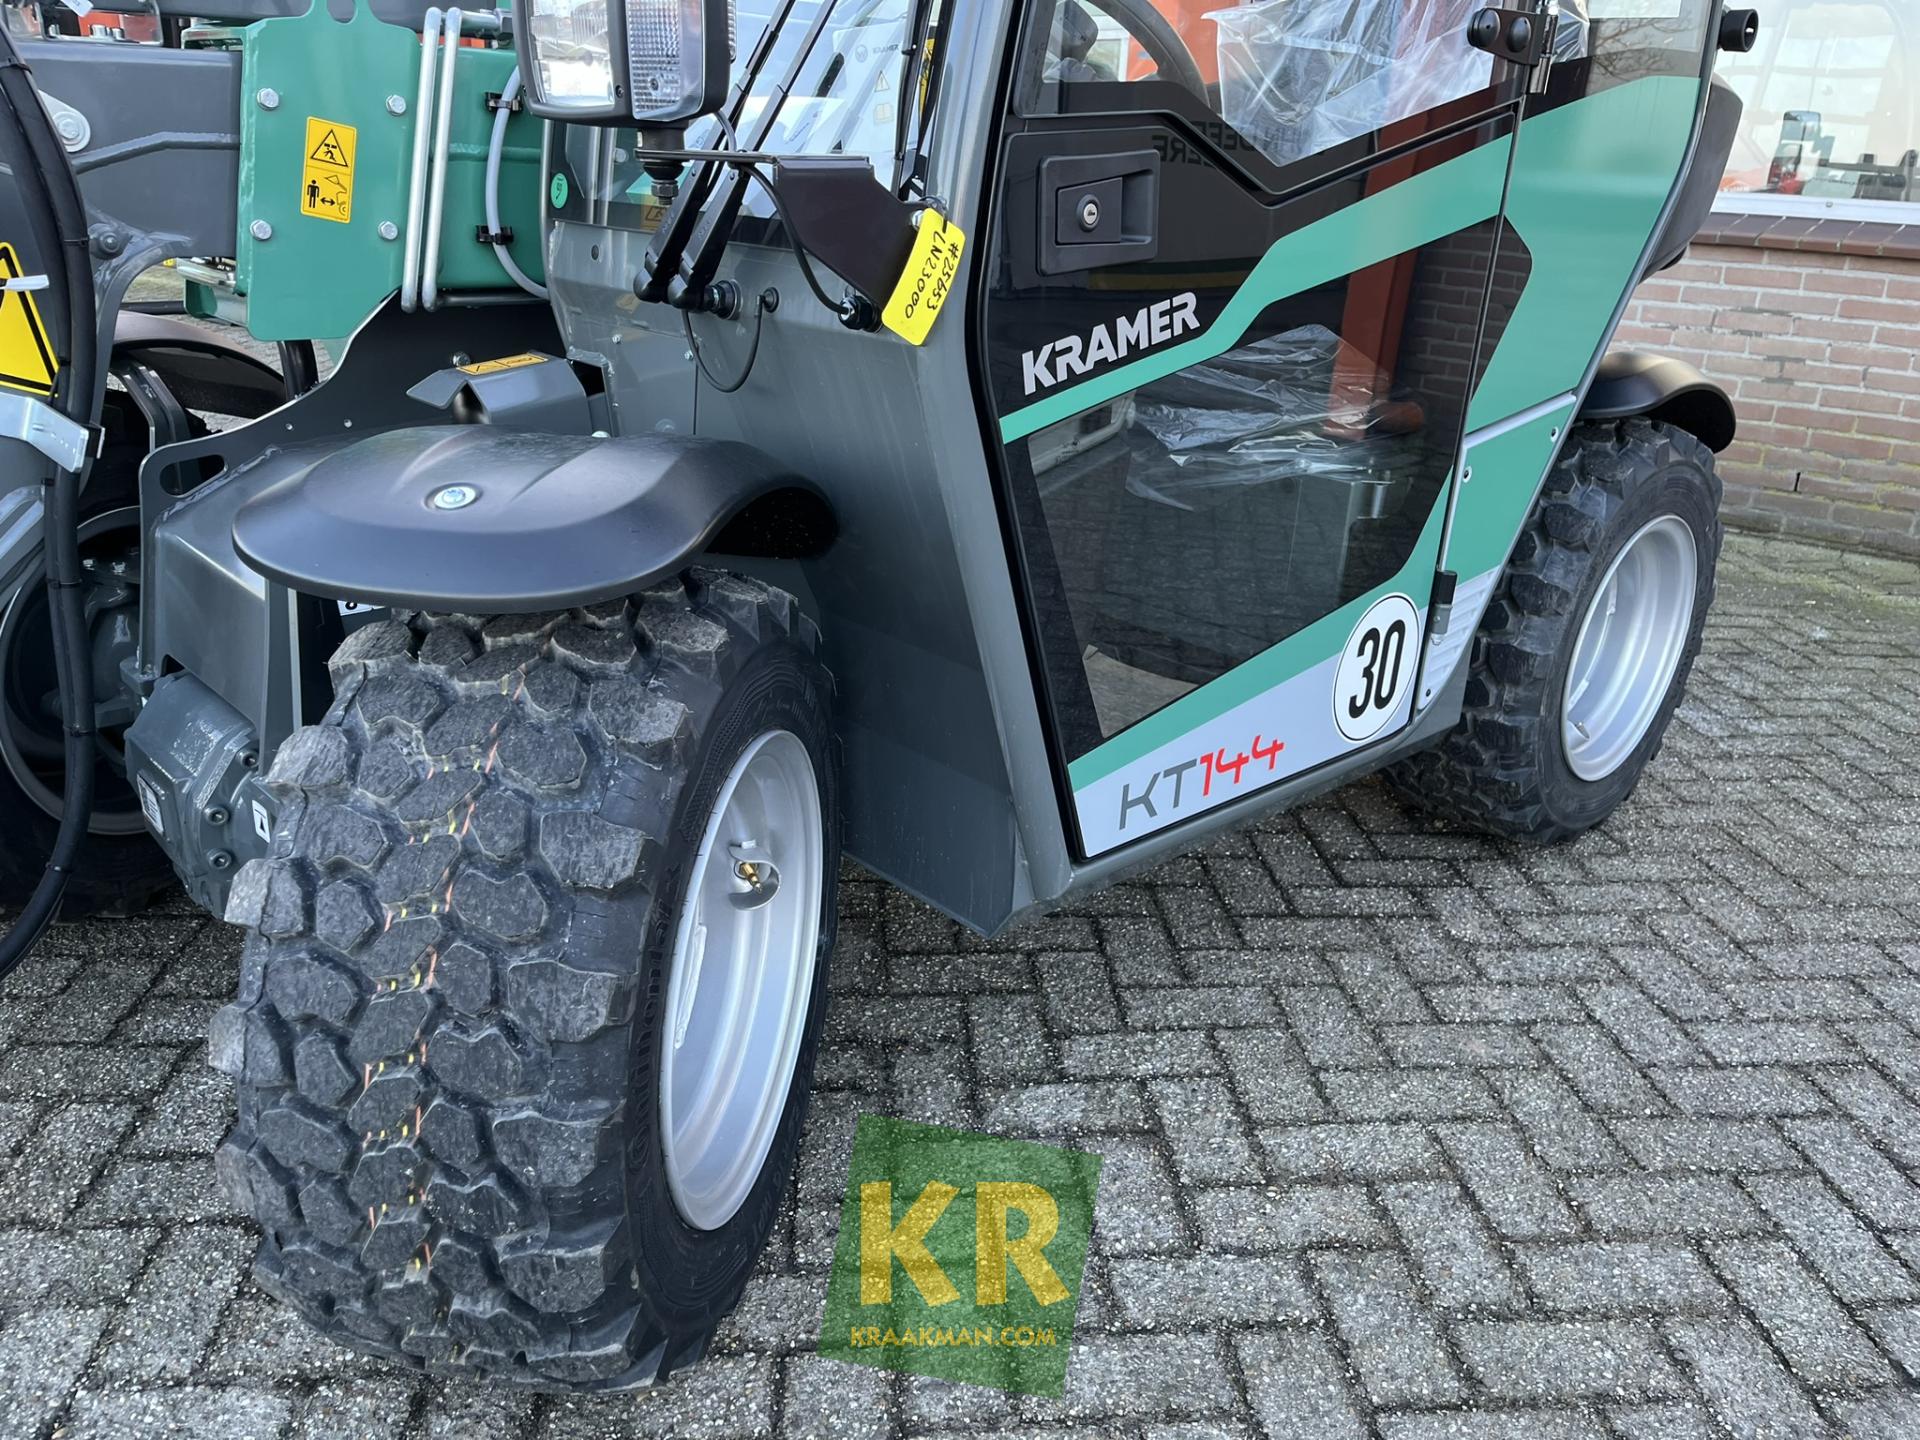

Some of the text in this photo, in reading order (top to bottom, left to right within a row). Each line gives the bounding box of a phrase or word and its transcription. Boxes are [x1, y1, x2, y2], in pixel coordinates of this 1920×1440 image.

[905, 230, 946, 319] LN23000
[926, 242, 959, 311] #25653
[1021, 291, 1201, 396] KRAMER
[1348, 618, 1406, 719] 30
[1119, 735, 1284, 830] KT144
